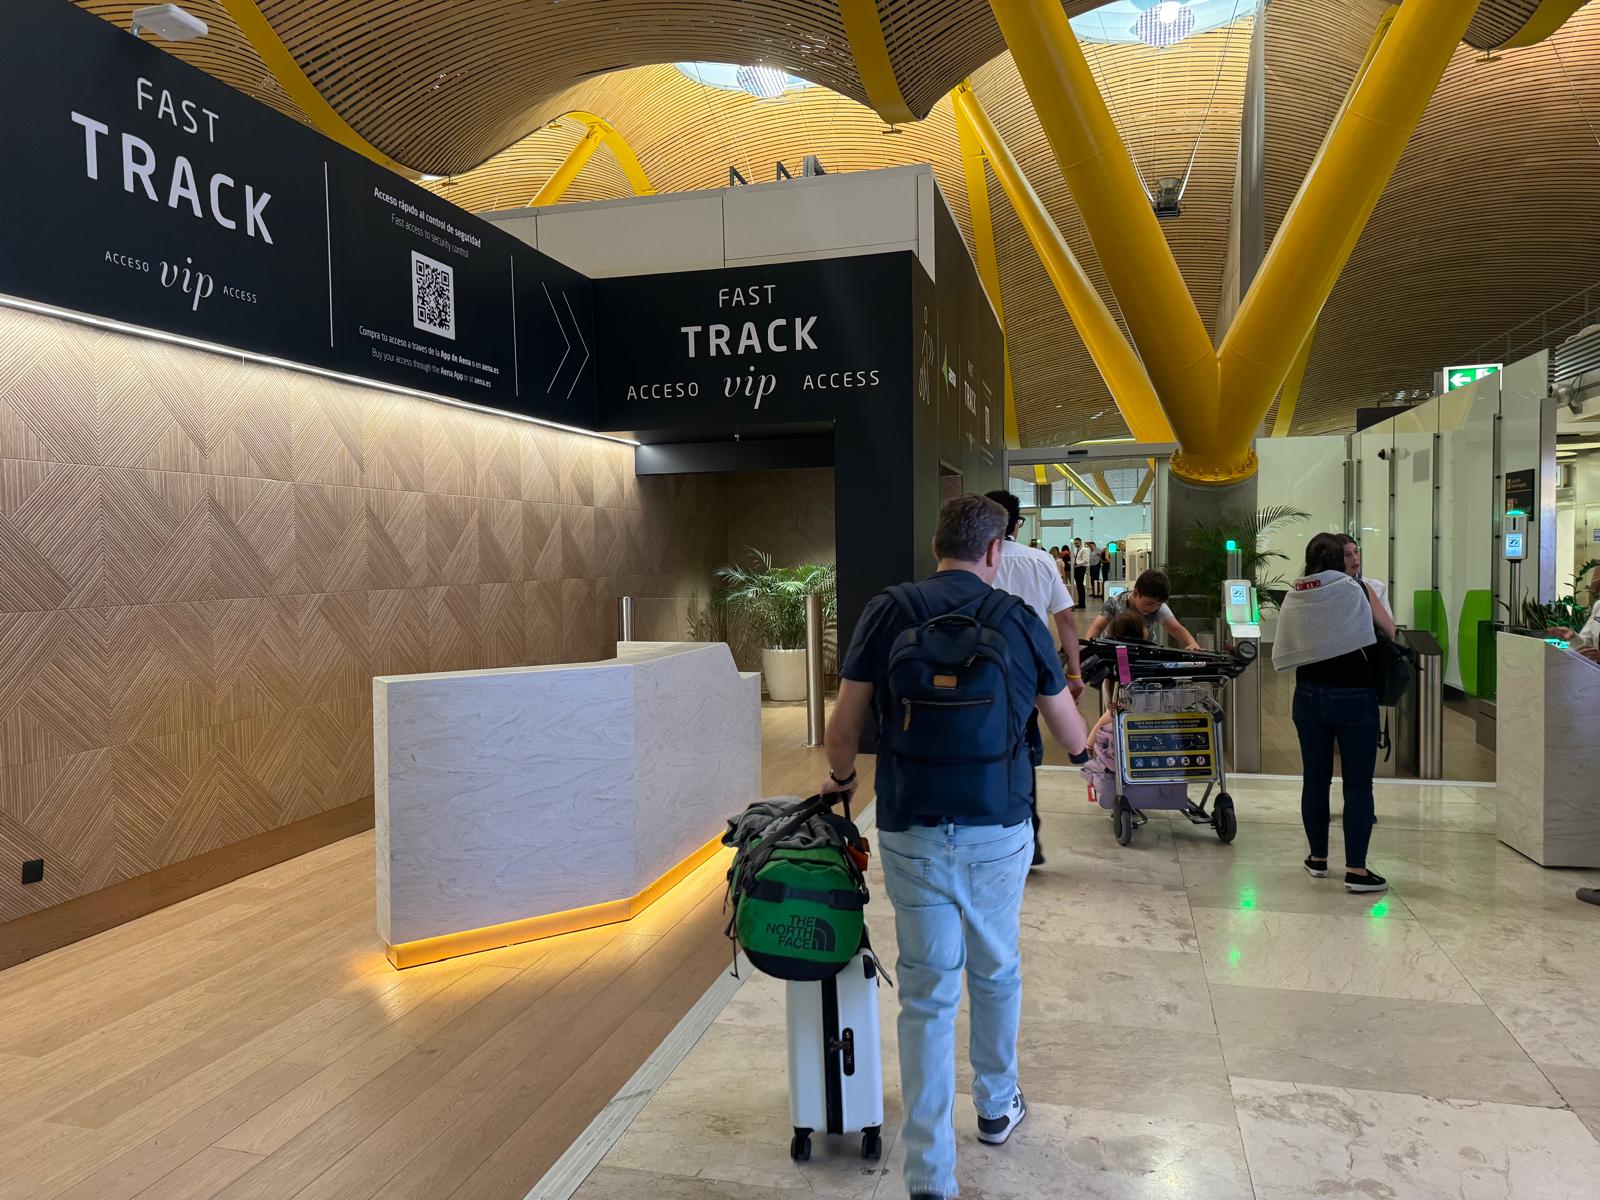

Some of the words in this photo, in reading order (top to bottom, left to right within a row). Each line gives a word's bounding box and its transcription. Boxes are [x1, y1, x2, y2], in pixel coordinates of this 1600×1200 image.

[136, 77, 220, 143] FAST
[71, 111, 274, 245] TRACK
[374, 187, 397, 206] Acceso
[398, 199, 419, 217] rápido
[419, 210, 425, 220] al
[425, 214, 446, 231] control
[446, 223, 454, 234] de
[455, 228, 480, 248] seguridad
[391, 213, 405, 229] Fast
[405, 221, 424, 237] access
[424, 229, 431, 240] to
[431, 234, 452, 252] security
[451, 244, 469, 258] control
[104, 250, 150, 273] ACCESO
[159, 256, 214, 312] vip
[223, 285, 258, 304] ACCESS
[718, 284, 777, 308] FAST
[359, 325, 381, 340] Compra
[381, 332, 388, 342] tu
[389, 335, 407, 348] acceso
[428, 346, 435, 355] de
[435, 348, 440, 357] la
[440, 350, 451, 361] App
[451, 353, 458, 362] de
[458, 355, 472, 367] Aena
[476, 361, 482, 369] en
[482, 363, 499, 374] aena.es
[680, 315, 819, 358] TRACK
[371, 347, 383, 361] Buy
[383, 353, 395, 363] your
[395, 356, 412, 367] access
[413, 360, 432, 373] through
[432, 364, 441, 374] the
[440, 366, 454, 378] Aena
[454, 369, 464, 381] App
[474, 377, 491, 388] aena.es
[626, 381, 699, 401] ACCESO
[722, 365, 777, 410] vip
[802, 370, 880, 390] ACCESS
[766, 923, 813, 939] NORTH
[778, 935, 811, 949] FACE
[790, 914, 815, 927] THE
